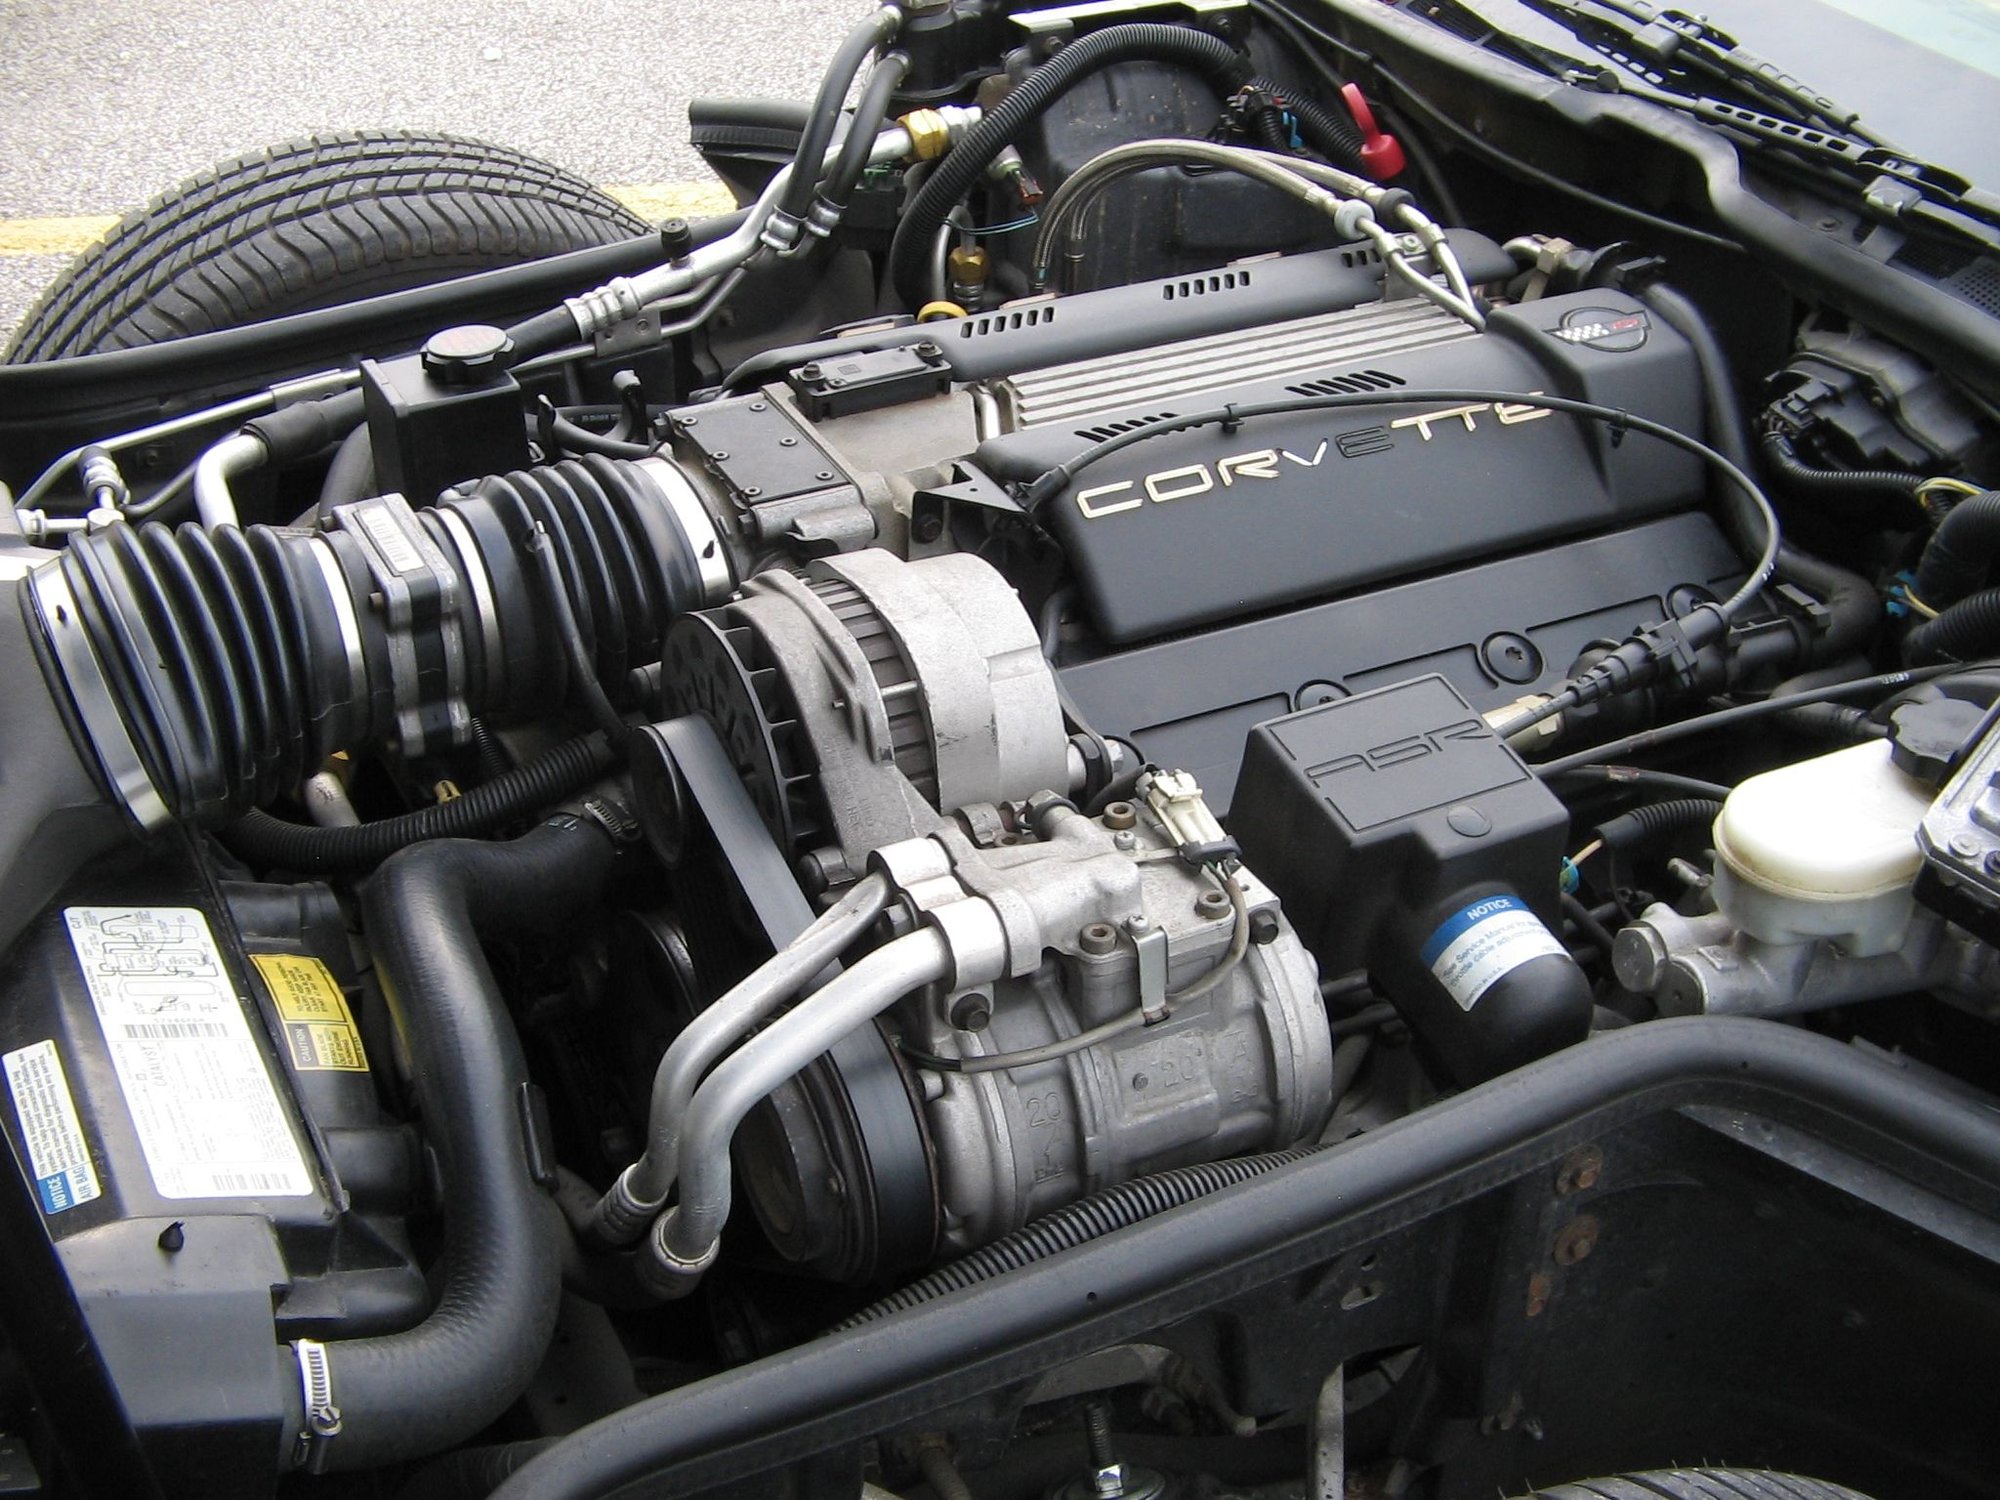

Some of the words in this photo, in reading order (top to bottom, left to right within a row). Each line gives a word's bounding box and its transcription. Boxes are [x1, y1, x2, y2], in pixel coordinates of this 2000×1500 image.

[1075, 391, 1553, 519] CORVETTE
[1303, 719, 1492, 788] ASR
[1467, 899, 1512, 920] NOTICE
[1456, 938, 1485, 963] Service
[1485, 924, 1515, 939] Manual
[1450, 962, 1474, 987] throttle
[1474, 945, 1495, 962] cable
[294, 1028, 312, 1061] CAUTION
[28, 1058, 40, 1078] service
[140, 1046, 168, 1086] CATALYST
[1026, 1091, 1062, 1128] 20
[55, 1147, 67, 1169] service
[72, 1167, 88, 1183] BAG
[47, 1177, 67, 1208] NOTICE
[77, 1185, 94, 1199] AIR
